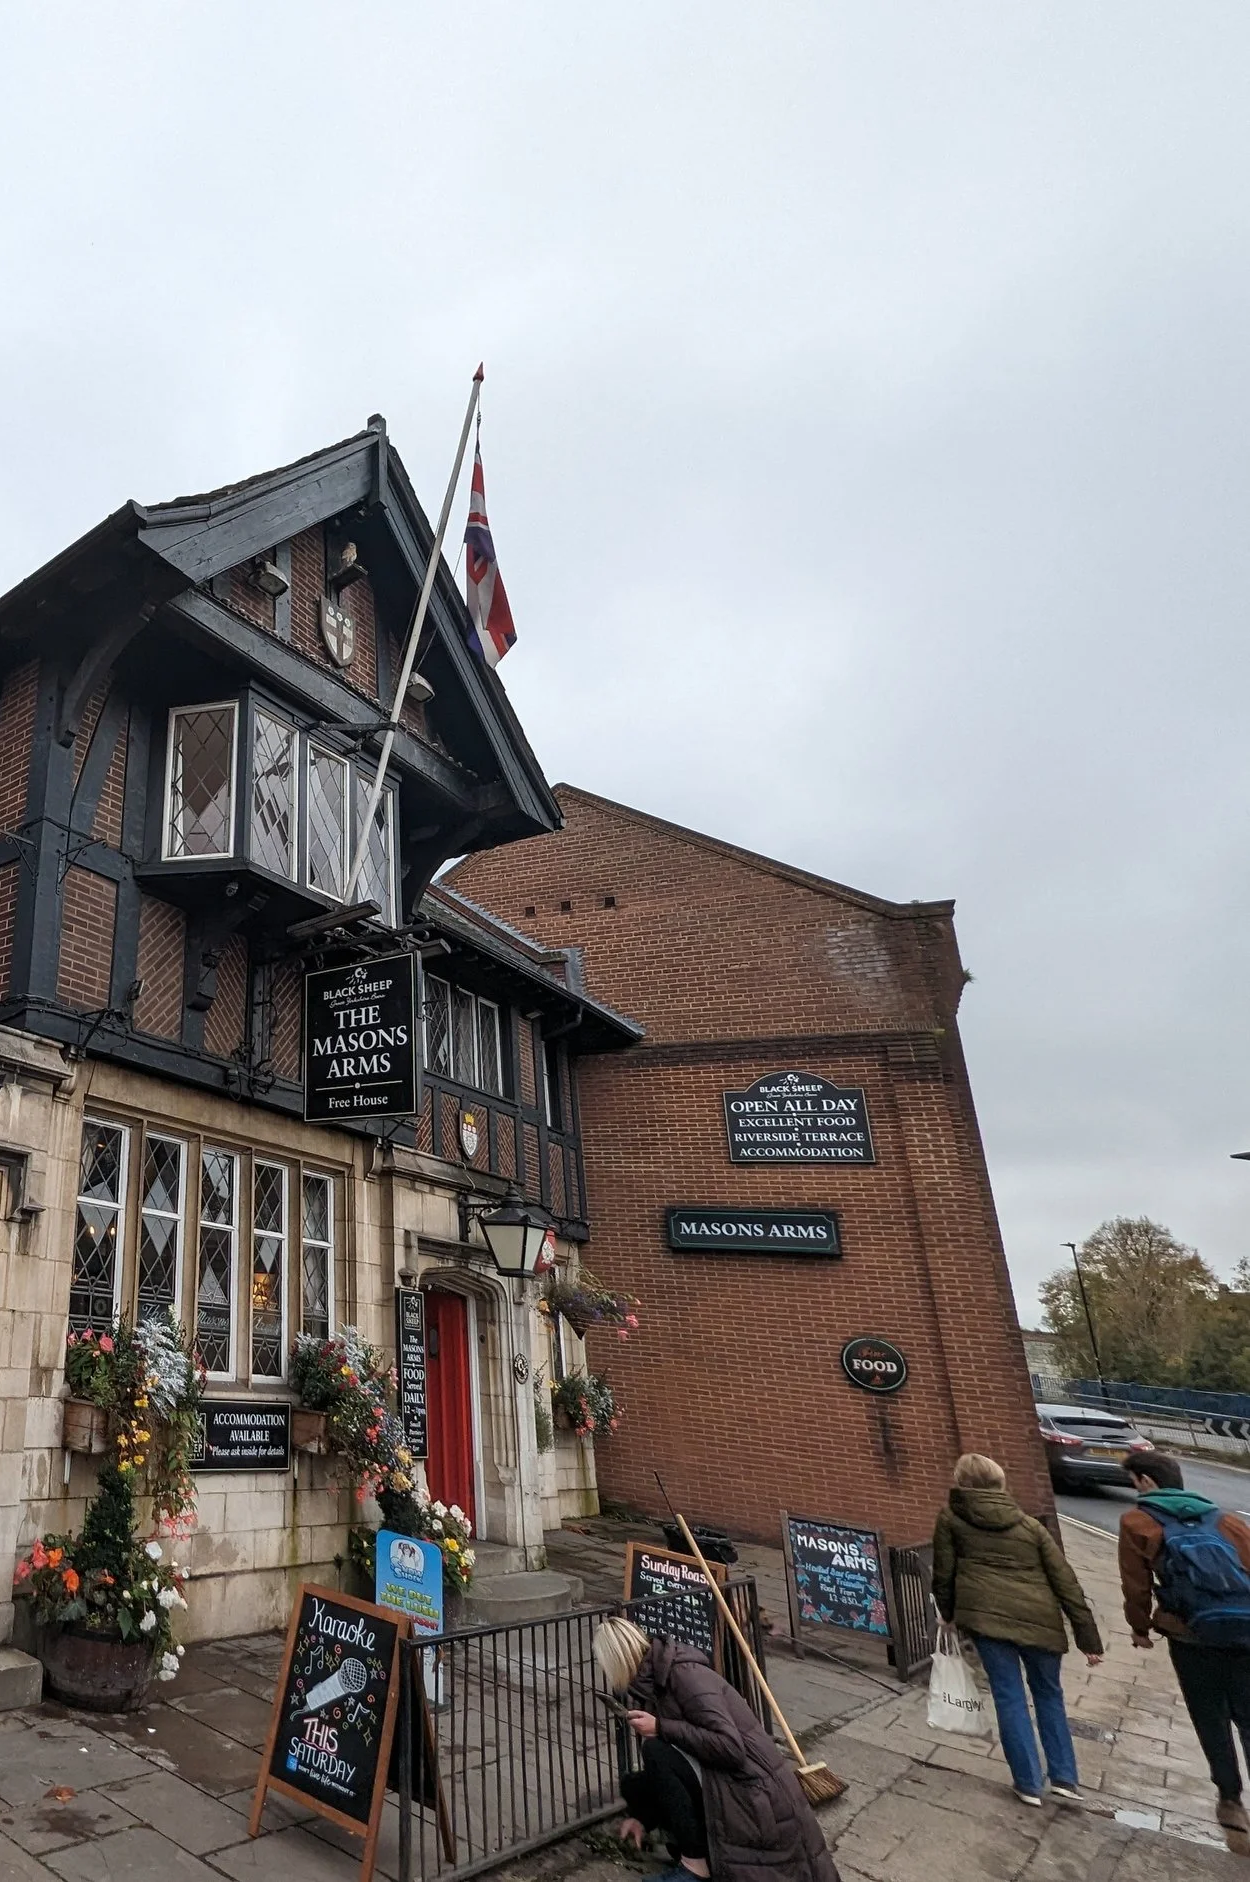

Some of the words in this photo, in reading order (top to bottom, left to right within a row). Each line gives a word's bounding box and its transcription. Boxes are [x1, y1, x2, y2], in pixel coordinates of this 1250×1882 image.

[323, 985, 356, 1001] BLACK
[358, 979, 393, 995] SHEEP
[334, 1005, 381, 1029] THE
[312, 1025, 408, 1057] MASONS
[326, 1052, 391, 1079] ARMS
[759, 1086, 790, 1094] BLACK
[791, 1084, 823, 1092] SHEEP
[328, 1097, 351, 1109] Free
[353, 1095, 389, 1107] House
[730, 1100, 779, 1113] OPEN
[784, 1099, 817, 1111] ALL
[822, 1098, 858, 1111] DAY
[738, 1117, 813, 1127] EXCELLENT
[817, 1117, 856, 1126] FOOD
[734, 1132, 801, 1142] RIVERSIDE
[802, 1132, 865, 1141] TERRACE
[740, 1147, 864, 1157] ACCOMMODATION
[680, 1221, 765, 1237] MASONS
[767, 1224, 828, 1239] ARMS
[142, 1303, 167, 1321] The
[409, 1335, 418, 1344] The
[403, 1343, 425, 1354] MASONS
[406, 1354, 422, 1363] ARMS
[852, 1358, 898, 1373] FOOD
[404, 1368, 425, 1380] FOOD
[406, 1381, 422, 1390] Served
[404, 1391, 425, 1404] DAILY
[213, 1413, 285, 1426] ACCOMMODATION
[229, 1430, 270, 1442] AVAILABLE
[212, 1445, 230, 1456] Please
[230, 1445, 240, 1456] ask
[241, 1446, 258, 1456] inside
[258, 1445, 267, 1458] for
[267, 1445, 285, 1456] details
[797, 1534, 859, 1556] MASONS
[641, 1554, 681, 1582] Sunday
[681, 1564, 710, 1586] Roas
[831, 1553, 877, 1572] ARMS
[386, 1582, 406, 1597] WE
[408, 1589, 433, 1605] PUT
[380, 1591, 404, 1607] THE
[405, 1600, 440, 1619] LUSH
[308, 1597, 375, 1651] Karaoke
[303, 1717, 339, 1752] THIS
[288, 1736, 356, 1783] SATURDAY
